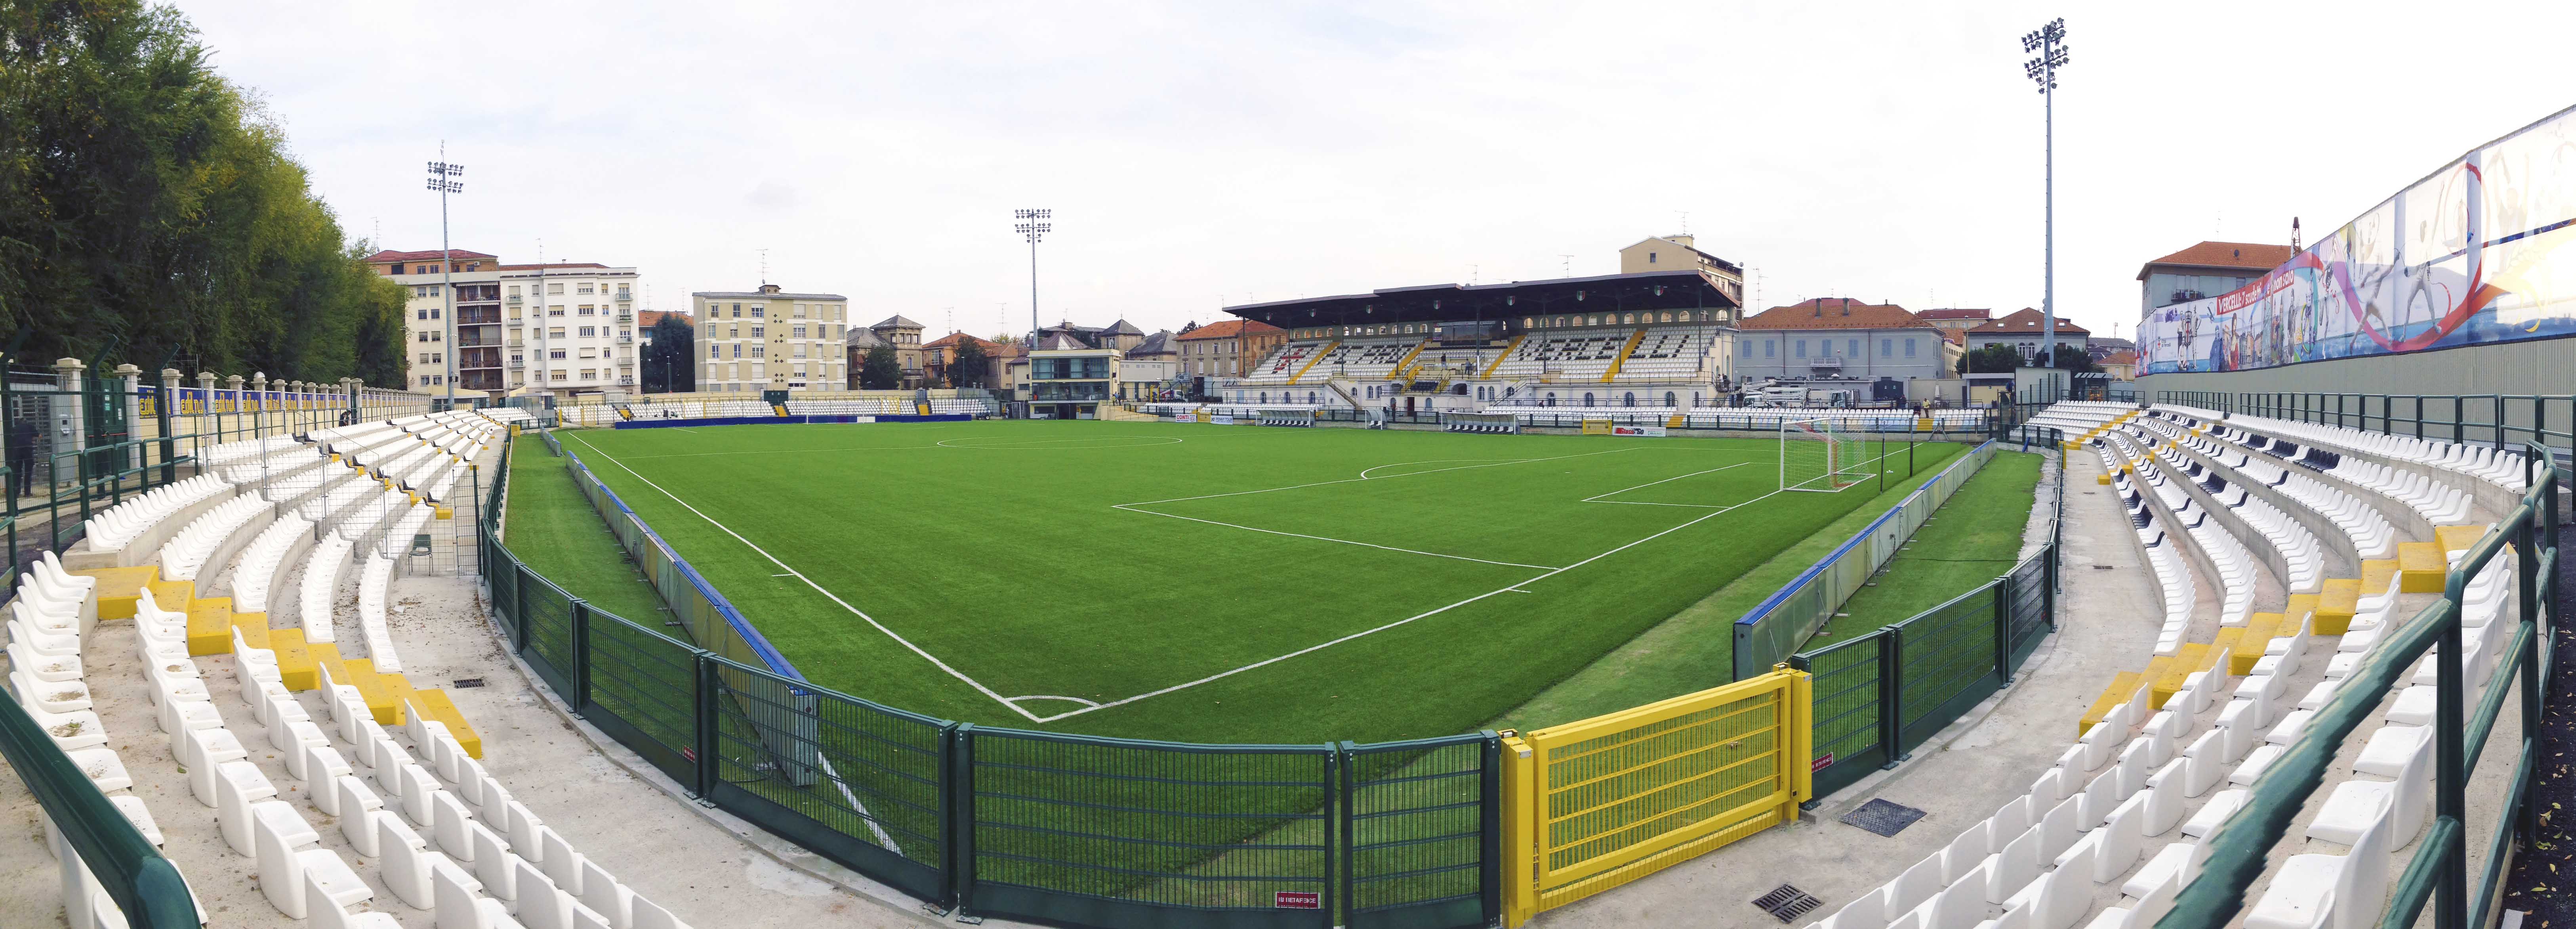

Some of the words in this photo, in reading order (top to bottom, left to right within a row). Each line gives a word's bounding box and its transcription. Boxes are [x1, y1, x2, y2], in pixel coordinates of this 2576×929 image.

[2218, 292, 2241, 313] VERCELLI:
[2242, 291, 2245, 306] 7
[2246, 282, 2261, 305] scudetti
[2273, 278, 2282, 291] non
[2283, 270, 2294, 286] solo
[181, 392, 206, 414] edilno
